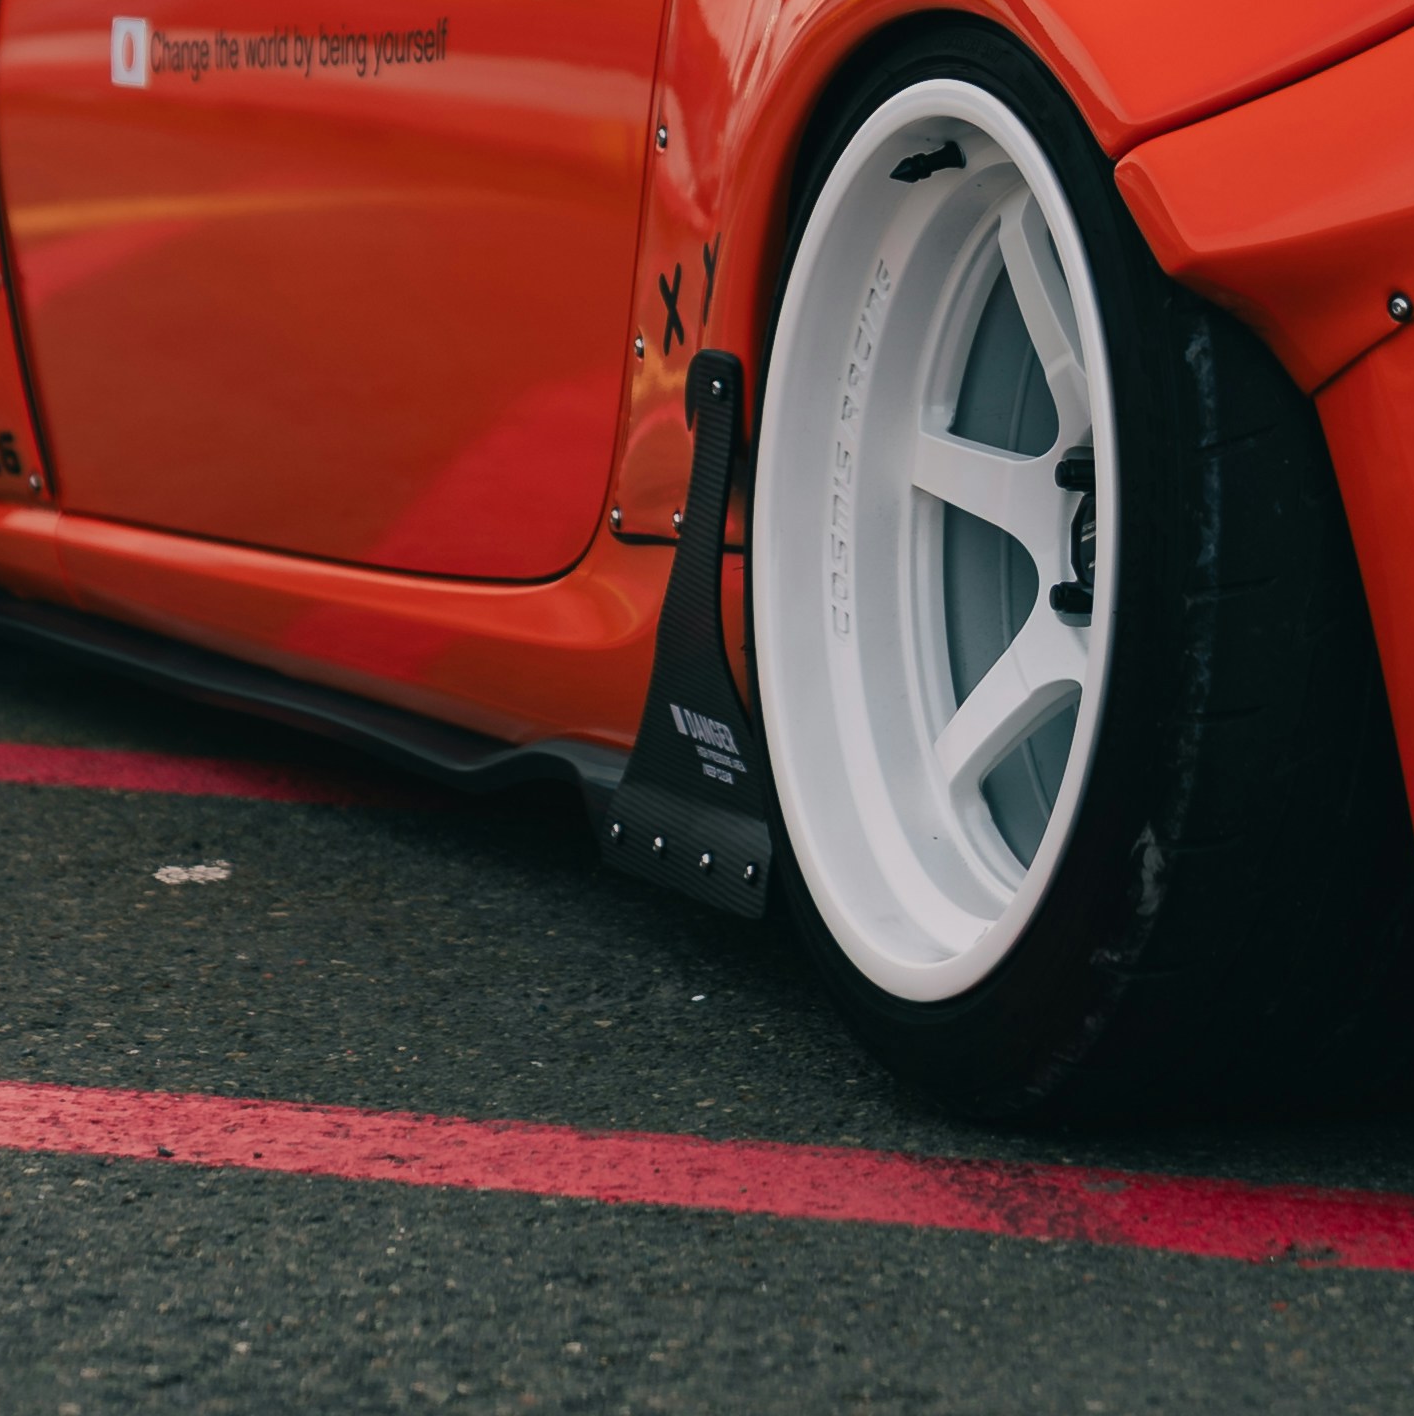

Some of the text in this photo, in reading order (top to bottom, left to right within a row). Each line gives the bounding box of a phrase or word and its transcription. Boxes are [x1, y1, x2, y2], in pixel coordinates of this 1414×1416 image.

[150, 16, 450, 83] Change the world by being yourself
[683, 708, 740, 755] DANGER
